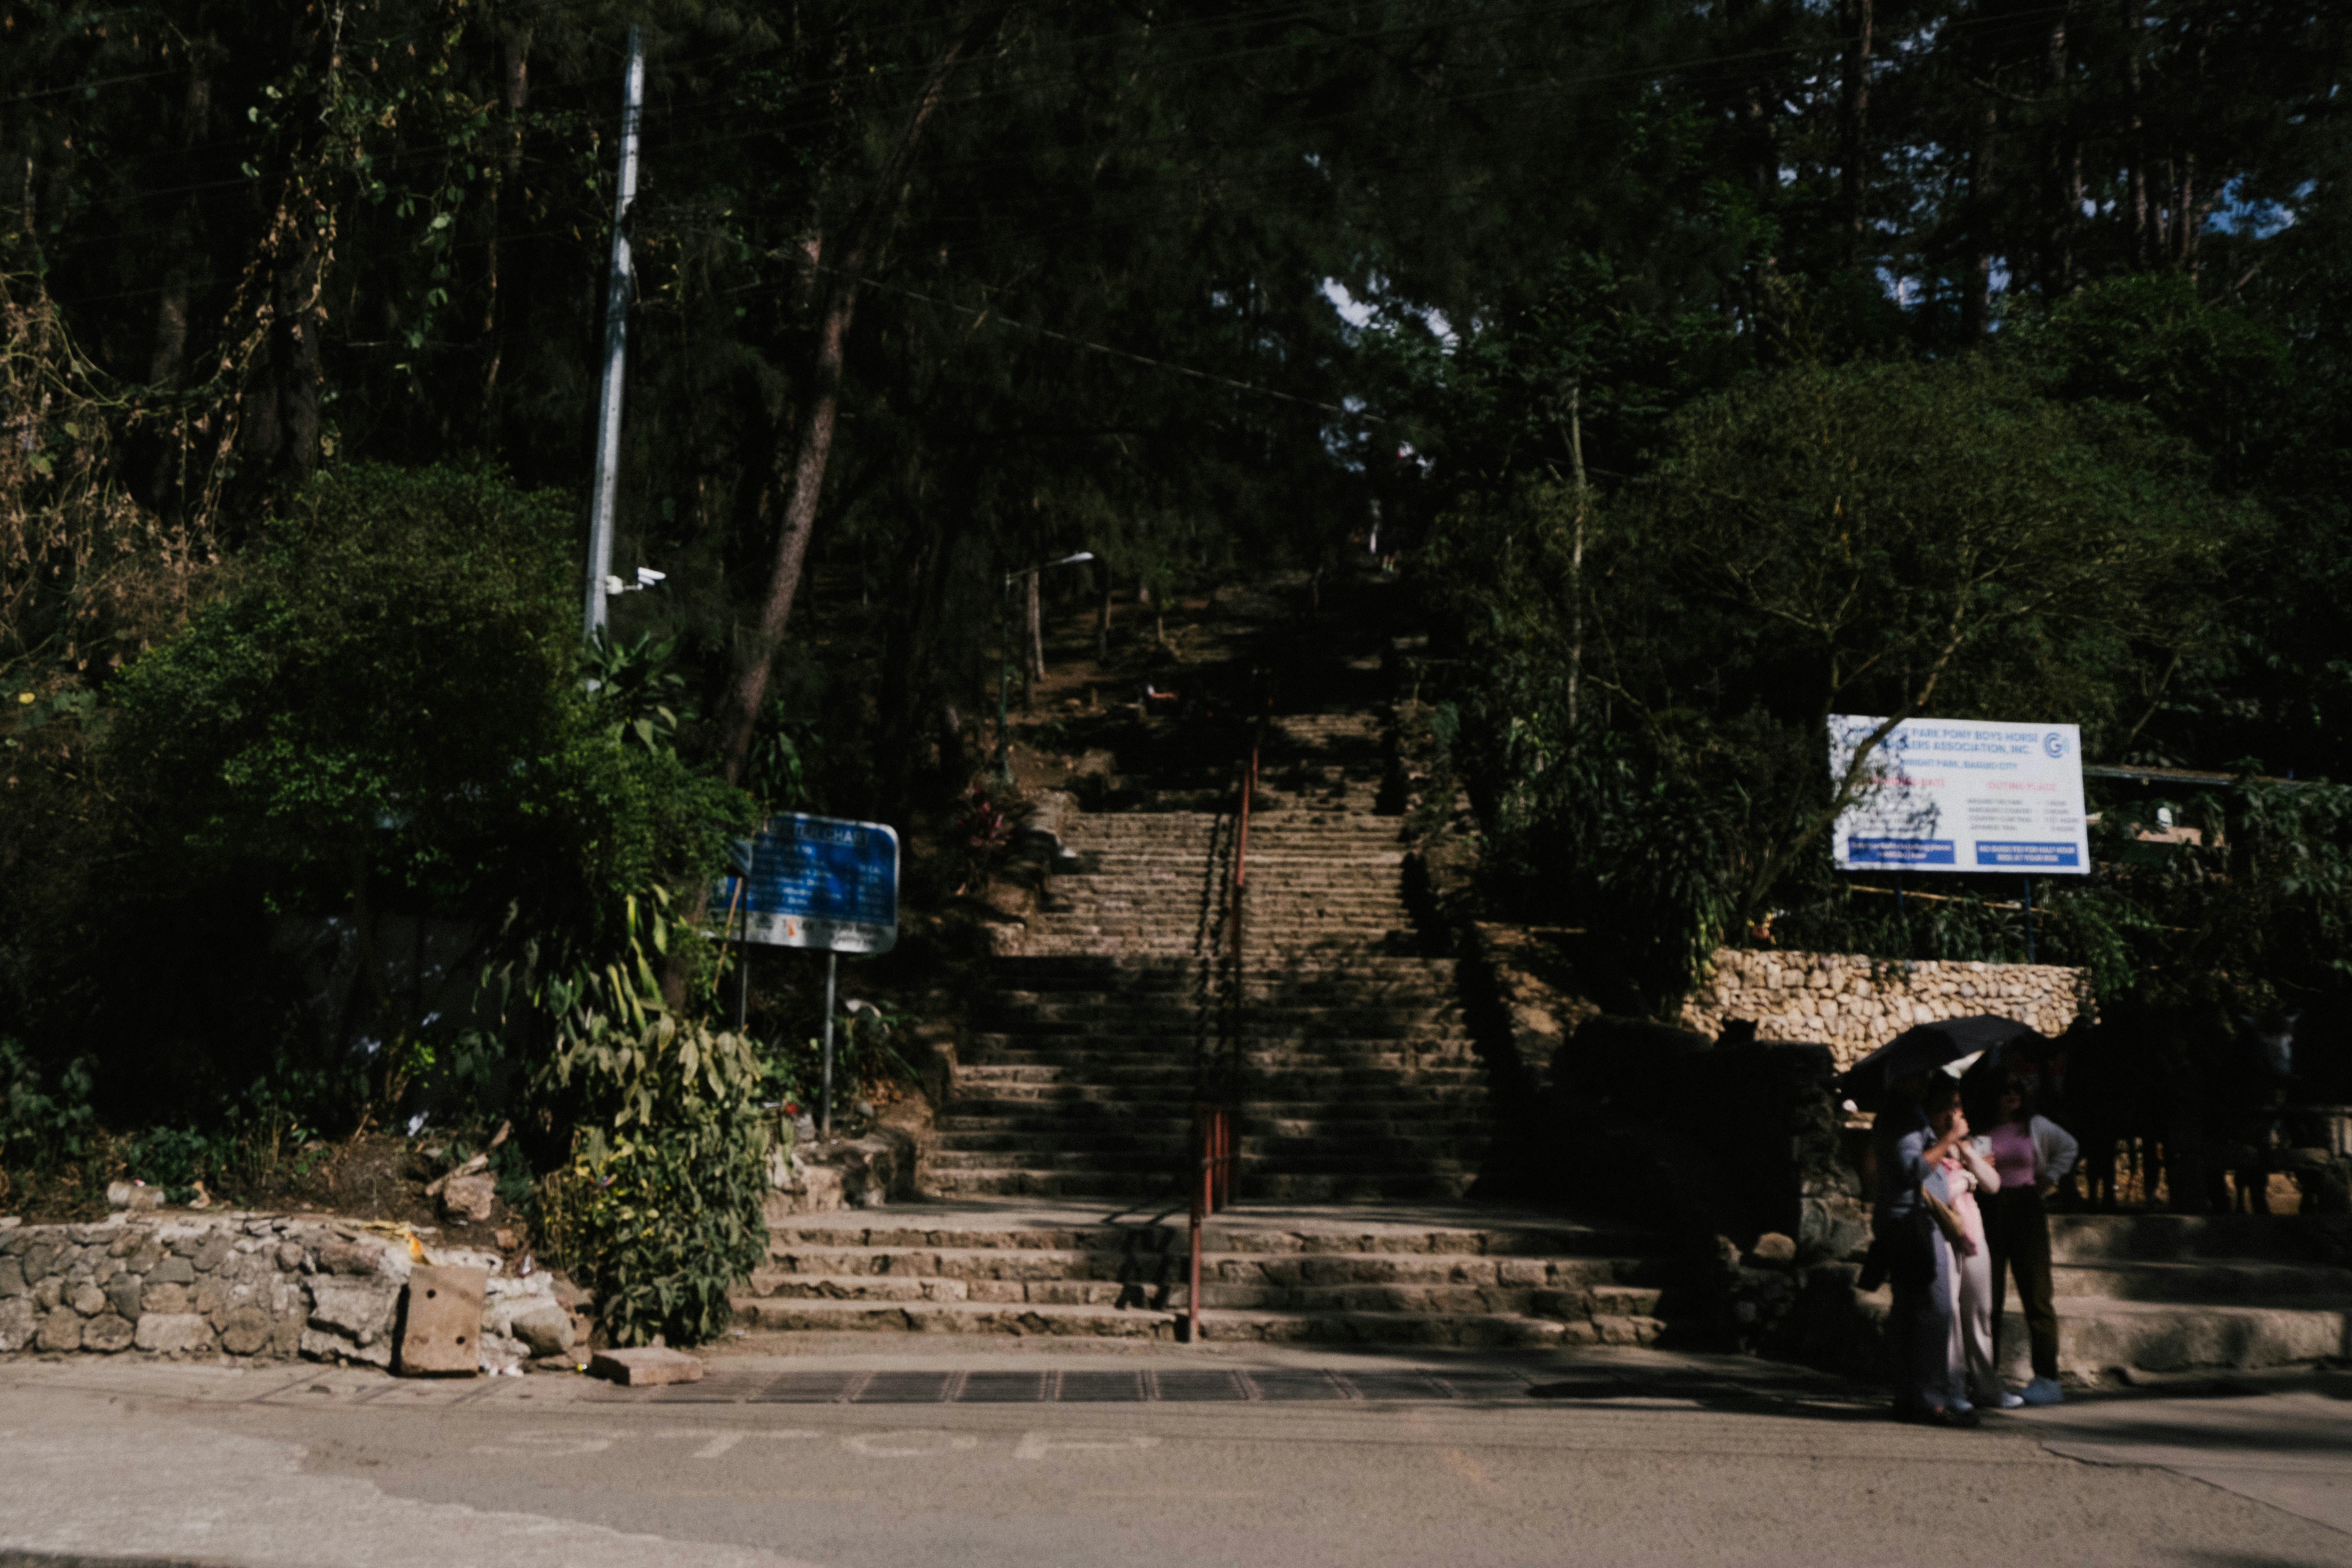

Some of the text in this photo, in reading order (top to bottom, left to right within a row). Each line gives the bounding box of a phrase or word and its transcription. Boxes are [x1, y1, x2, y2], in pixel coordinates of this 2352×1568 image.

[1912, 727, 1939, 738] PARK
[1943, 729, 1972, 739] PONY
[1975, 730, 2004, 741] BOYS
[2006, 732, 2038, 742] HORSE
[2012, 744, 2032, 754] INC.
[469, 1428, 1160, 1459] STOP
